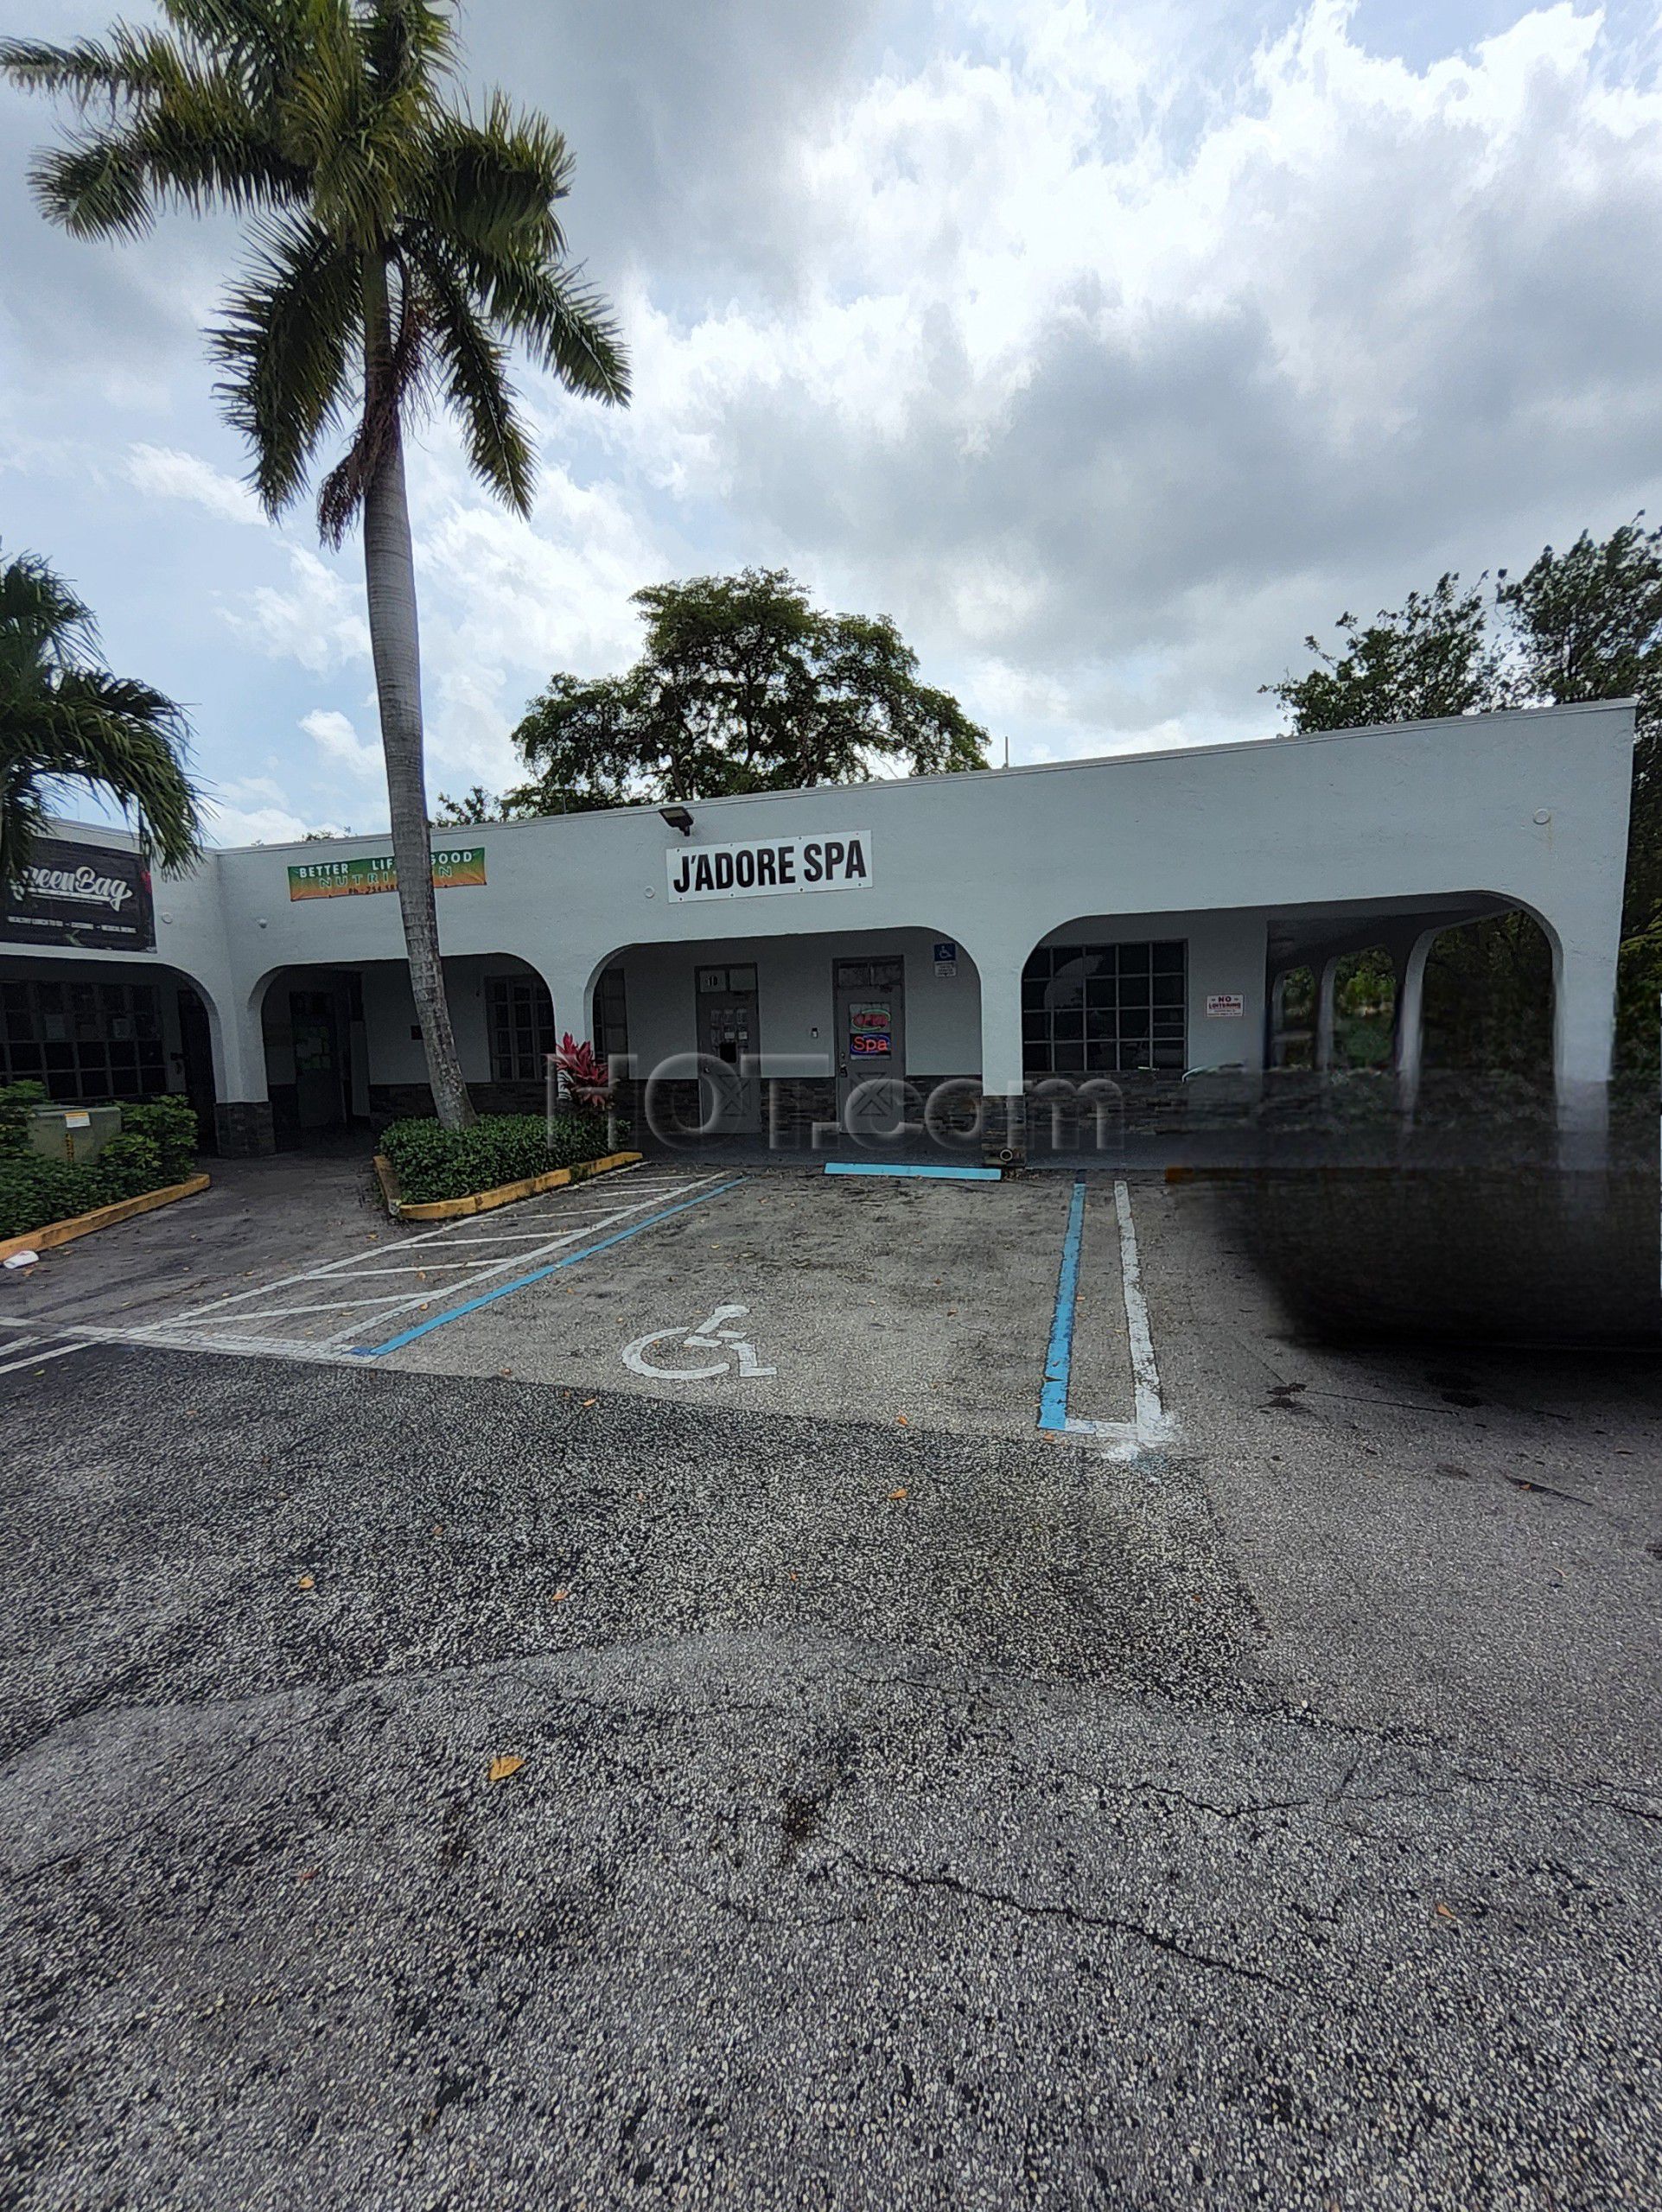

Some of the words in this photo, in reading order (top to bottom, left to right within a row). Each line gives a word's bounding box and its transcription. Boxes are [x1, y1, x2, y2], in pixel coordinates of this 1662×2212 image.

[299, 863, 348, 878] BETTER
[803, 840, 867, 882] SPA
[319, 865, 452, 889] NUTRIN
[854, 1036, 888, 1052] Spa
